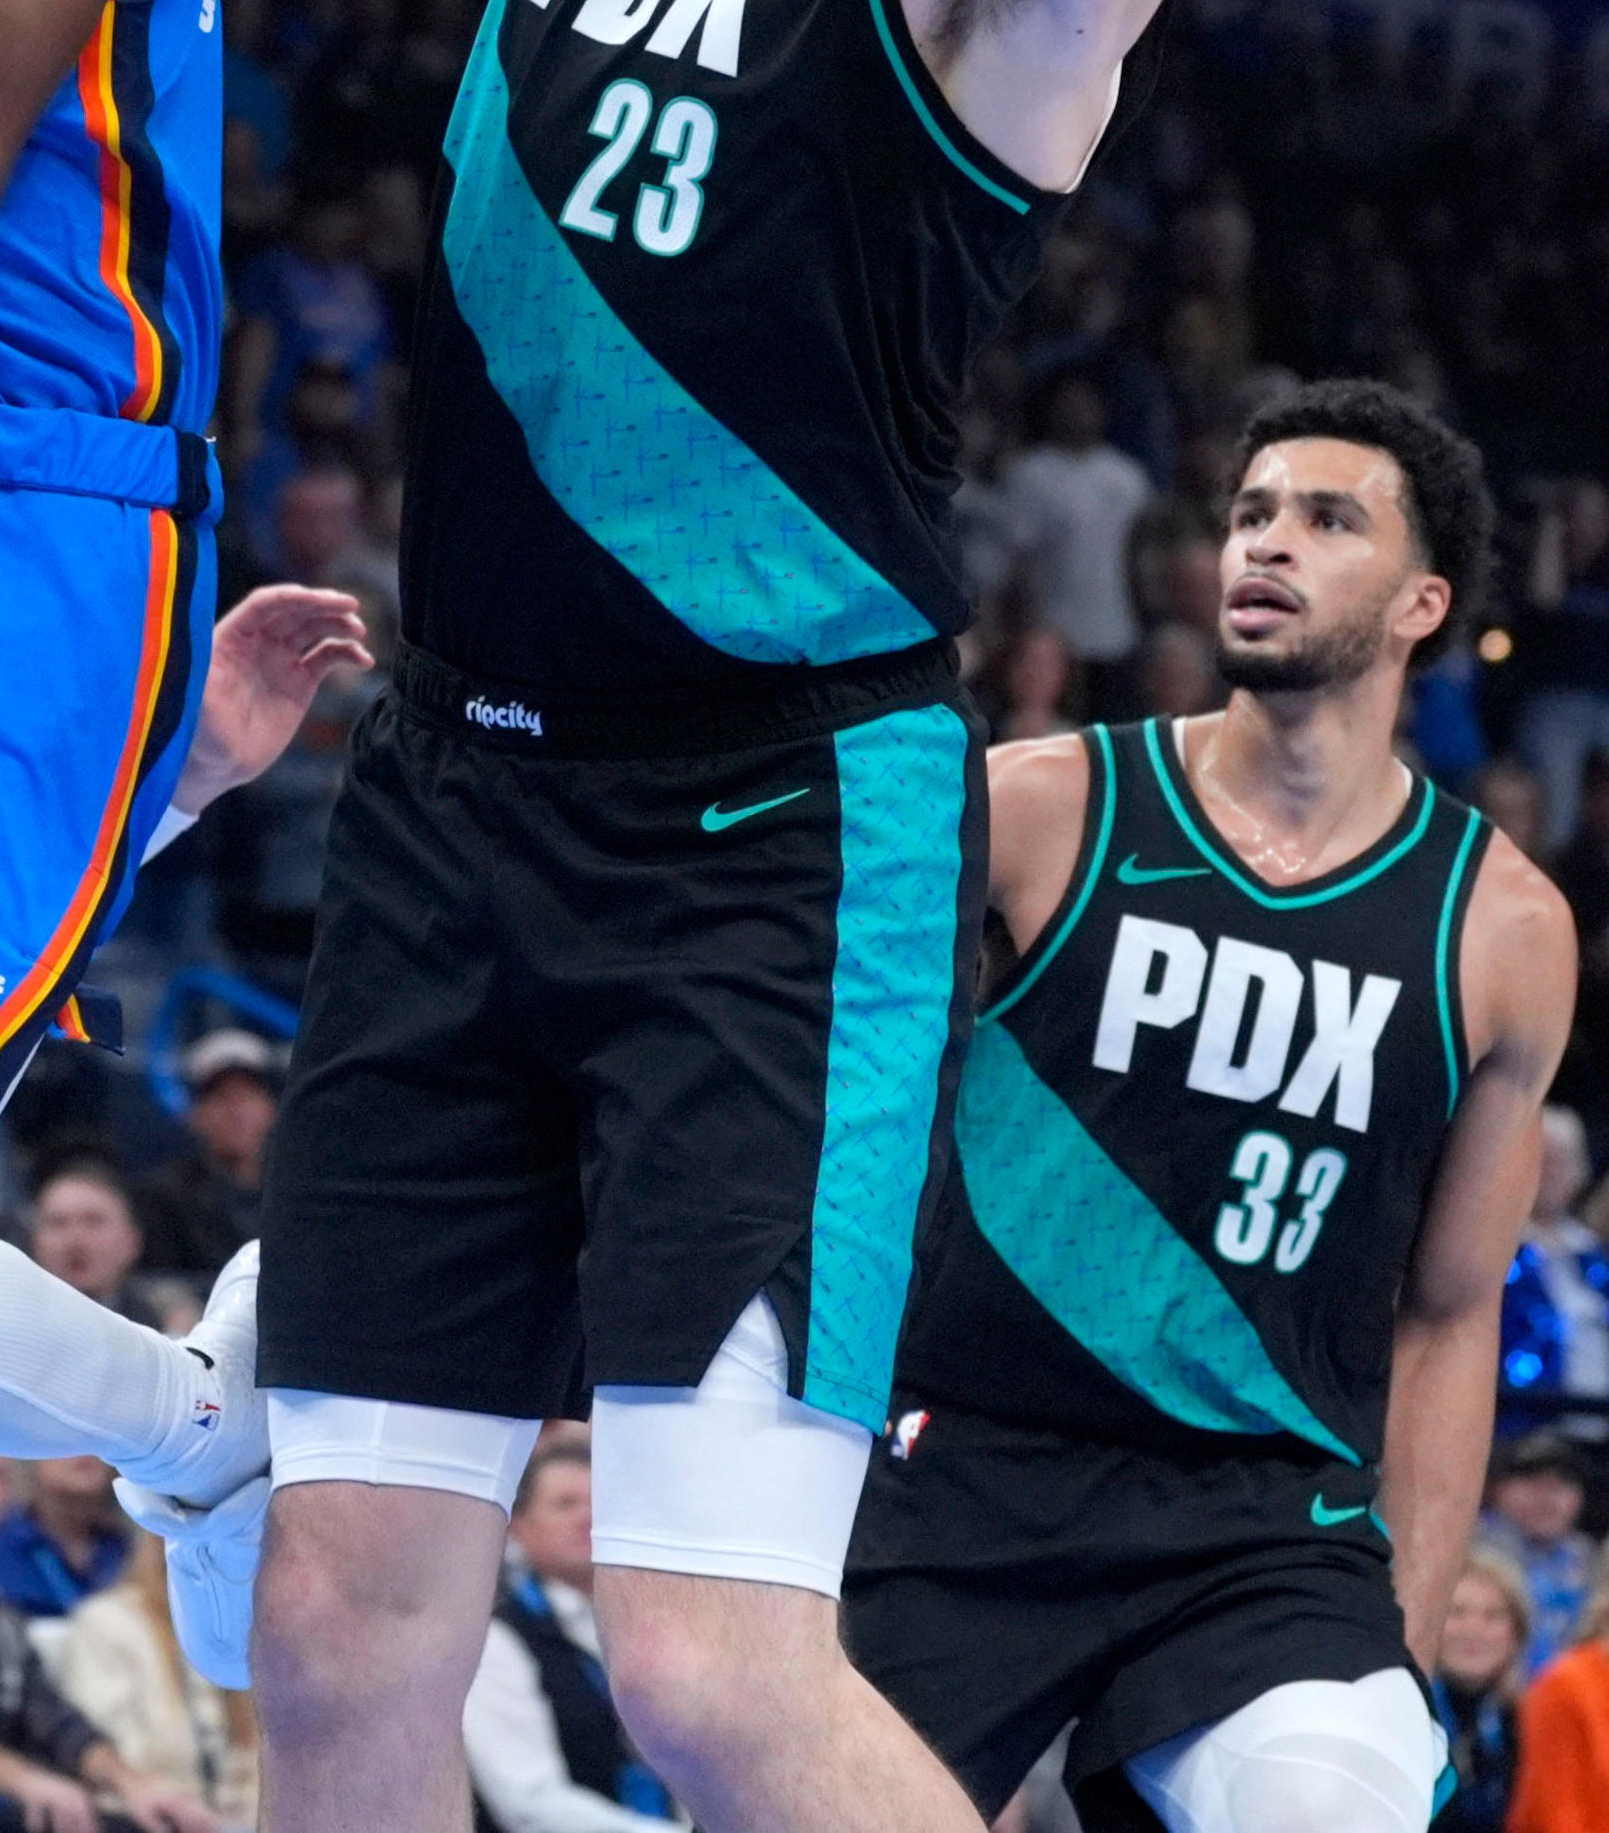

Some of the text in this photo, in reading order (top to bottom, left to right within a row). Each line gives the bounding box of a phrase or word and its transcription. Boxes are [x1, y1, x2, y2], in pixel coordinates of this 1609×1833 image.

[559, 78, 717, 257] 23
[1092, 914, 1402, 1134] PDX
[1214, 1129, 1348, 1275] 33
